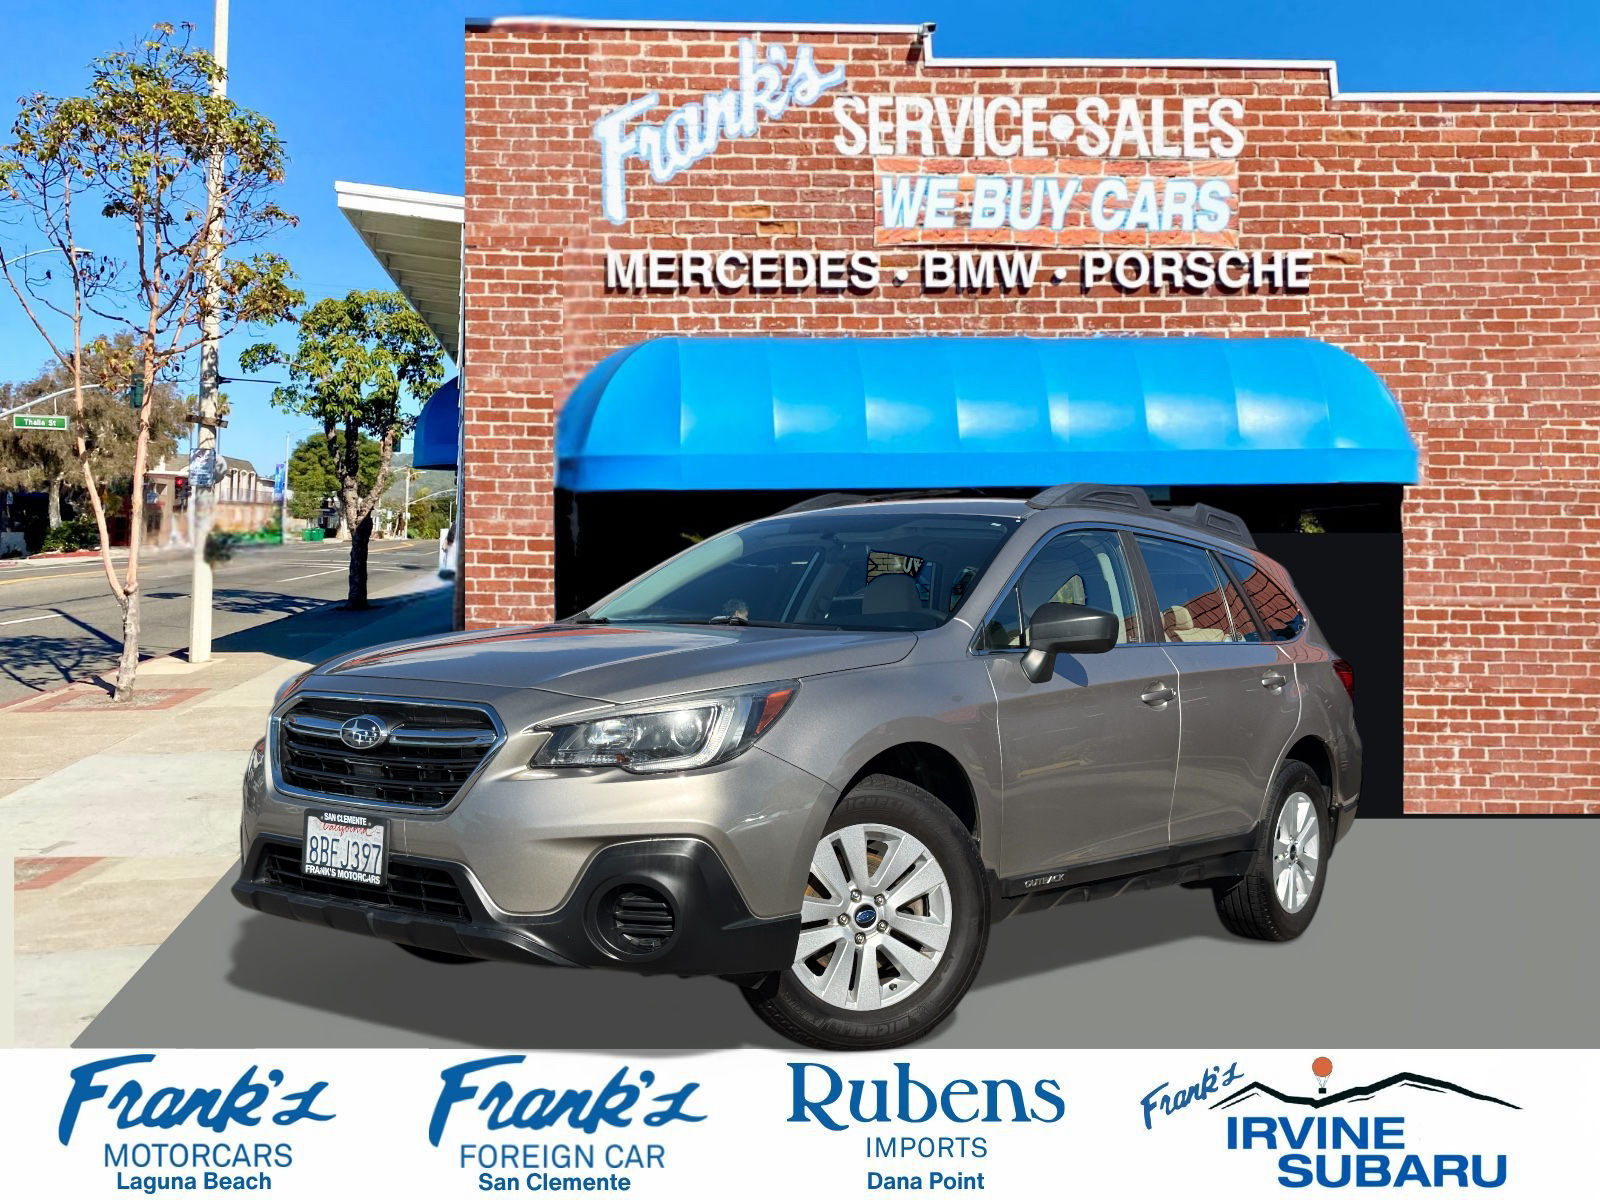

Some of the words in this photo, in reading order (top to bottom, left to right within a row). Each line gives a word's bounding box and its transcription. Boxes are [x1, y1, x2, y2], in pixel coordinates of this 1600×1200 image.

[594, 37, 846, 225] Frank's
[833, 96, 1047, 157] SERVICE
[1075, 97, 1245, 157] SALES
[880, 176, 958, 229] WE
[970, 176, 1082, 230] BUY
[1090, 177, 1232, 232] CARS
[606, 250, 881, 291] MERCEDES
[923, 250, 1041, 289] BMW
[1084, 250, 1314, 290] PORSCHE
[48, 419, 57, 427] St
[324, 812, 337, 822] SAN
[337, 814, 367, 825] CLEMENTE
[305, 864, 336, 877] FRANK'S
[337, 869, 380, 884] MOTORCARS
[309, 835, 381, 874] 8BFJ397
[1024, 873, 1066, 888] OUTBACK
